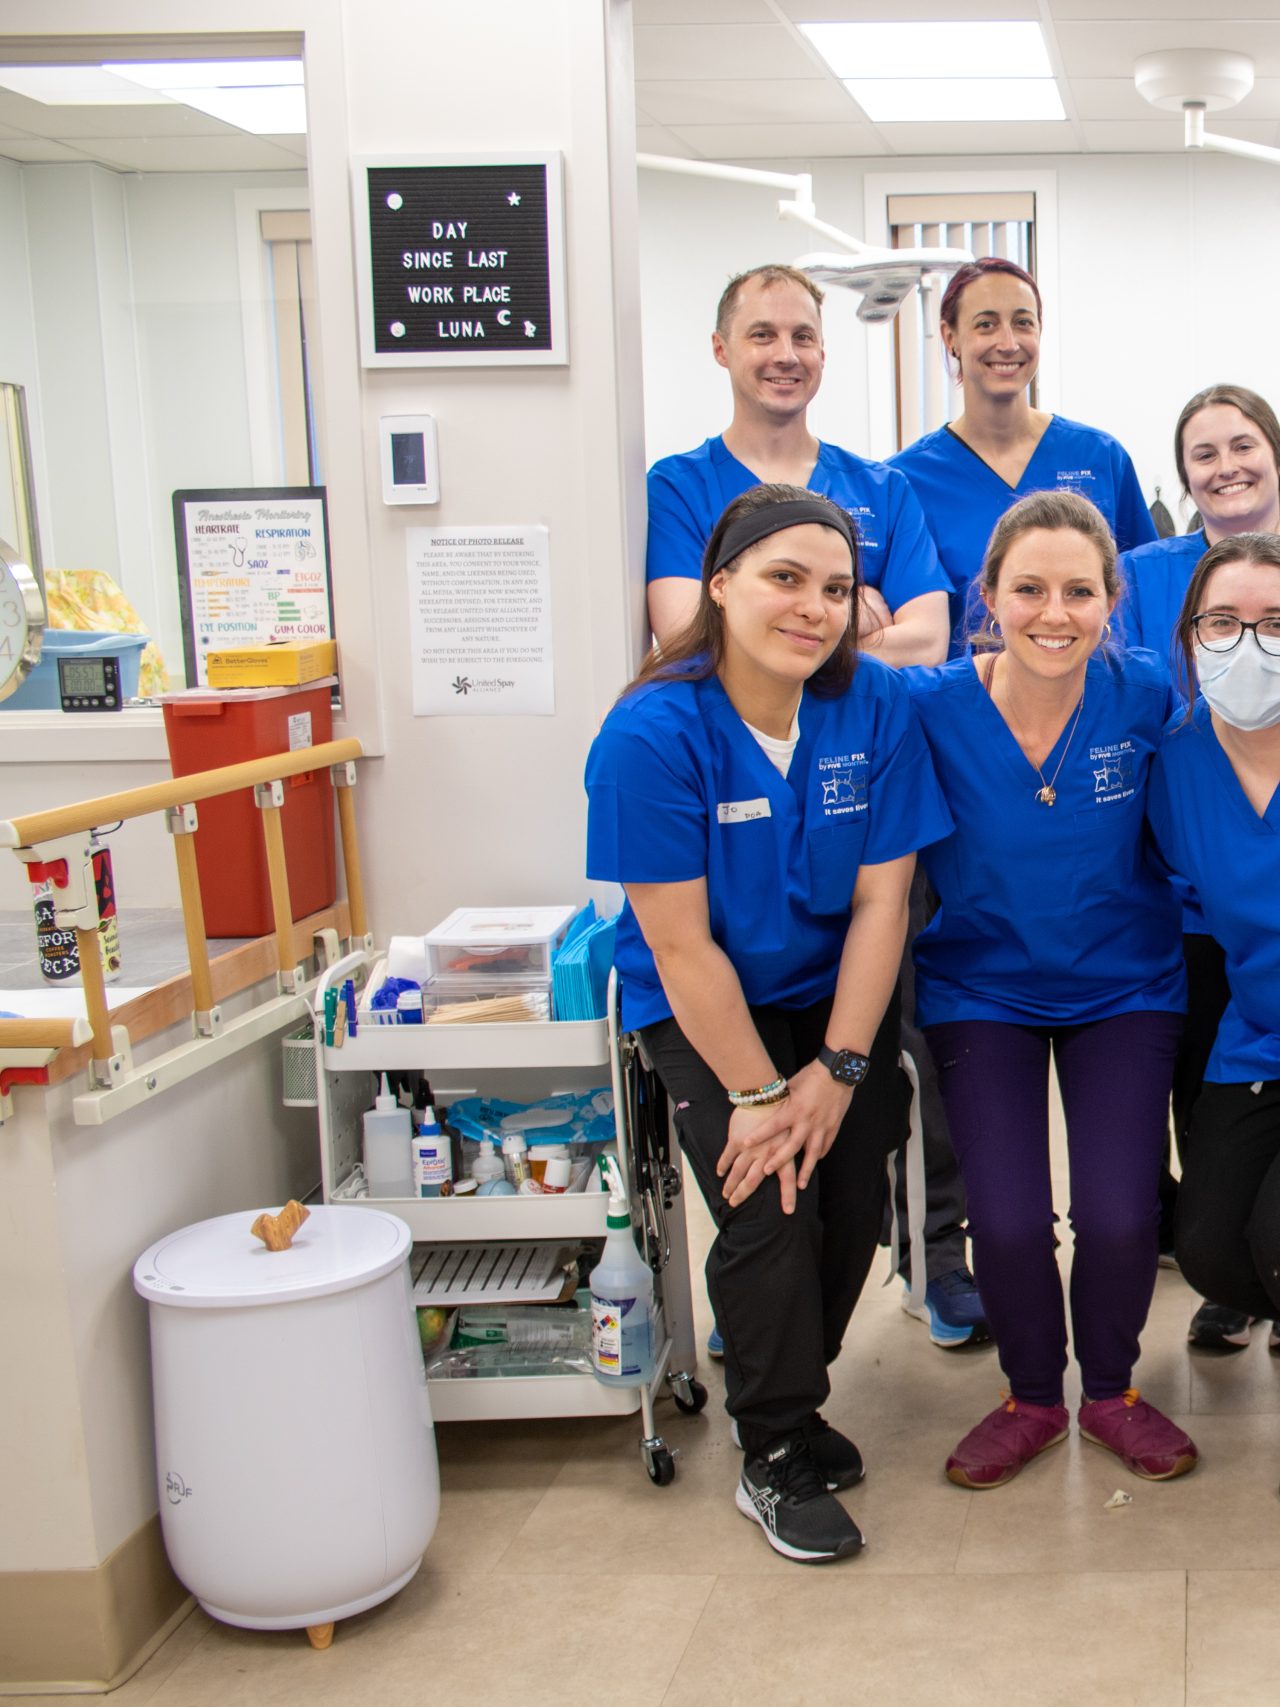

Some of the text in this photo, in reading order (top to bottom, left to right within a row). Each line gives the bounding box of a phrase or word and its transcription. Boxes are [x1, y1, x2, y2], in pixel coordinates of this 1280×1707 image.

[432, 222, 468, 239] DAY
[402, 251, 508, 269] SINCE LAST
[408, 286, 511, 303] WORK PLACE
[438, 321, 486, 338] LUNA
[198, 508, 311, 523] Anesthesia Monitoring
[195, 524, 240, 534] HEARTRATE
[255, 528, 310, 538] RESPIRATION
[195, 578, 250, 588] TEMPERATURE
[268, 592, 280, 600] BP
[2, 600, 20, 627] 3
[200, 623, 257, 632] EYE POSITION
[274, 624, 326, 634] GUM COLOR
[1090, 741, 1131, 754] FELINE FIX
[819, 753, 865, 764] FELINE FIX
[1103, 793, 1122, 802] saves
[722, 804, 737, 815] Jo
